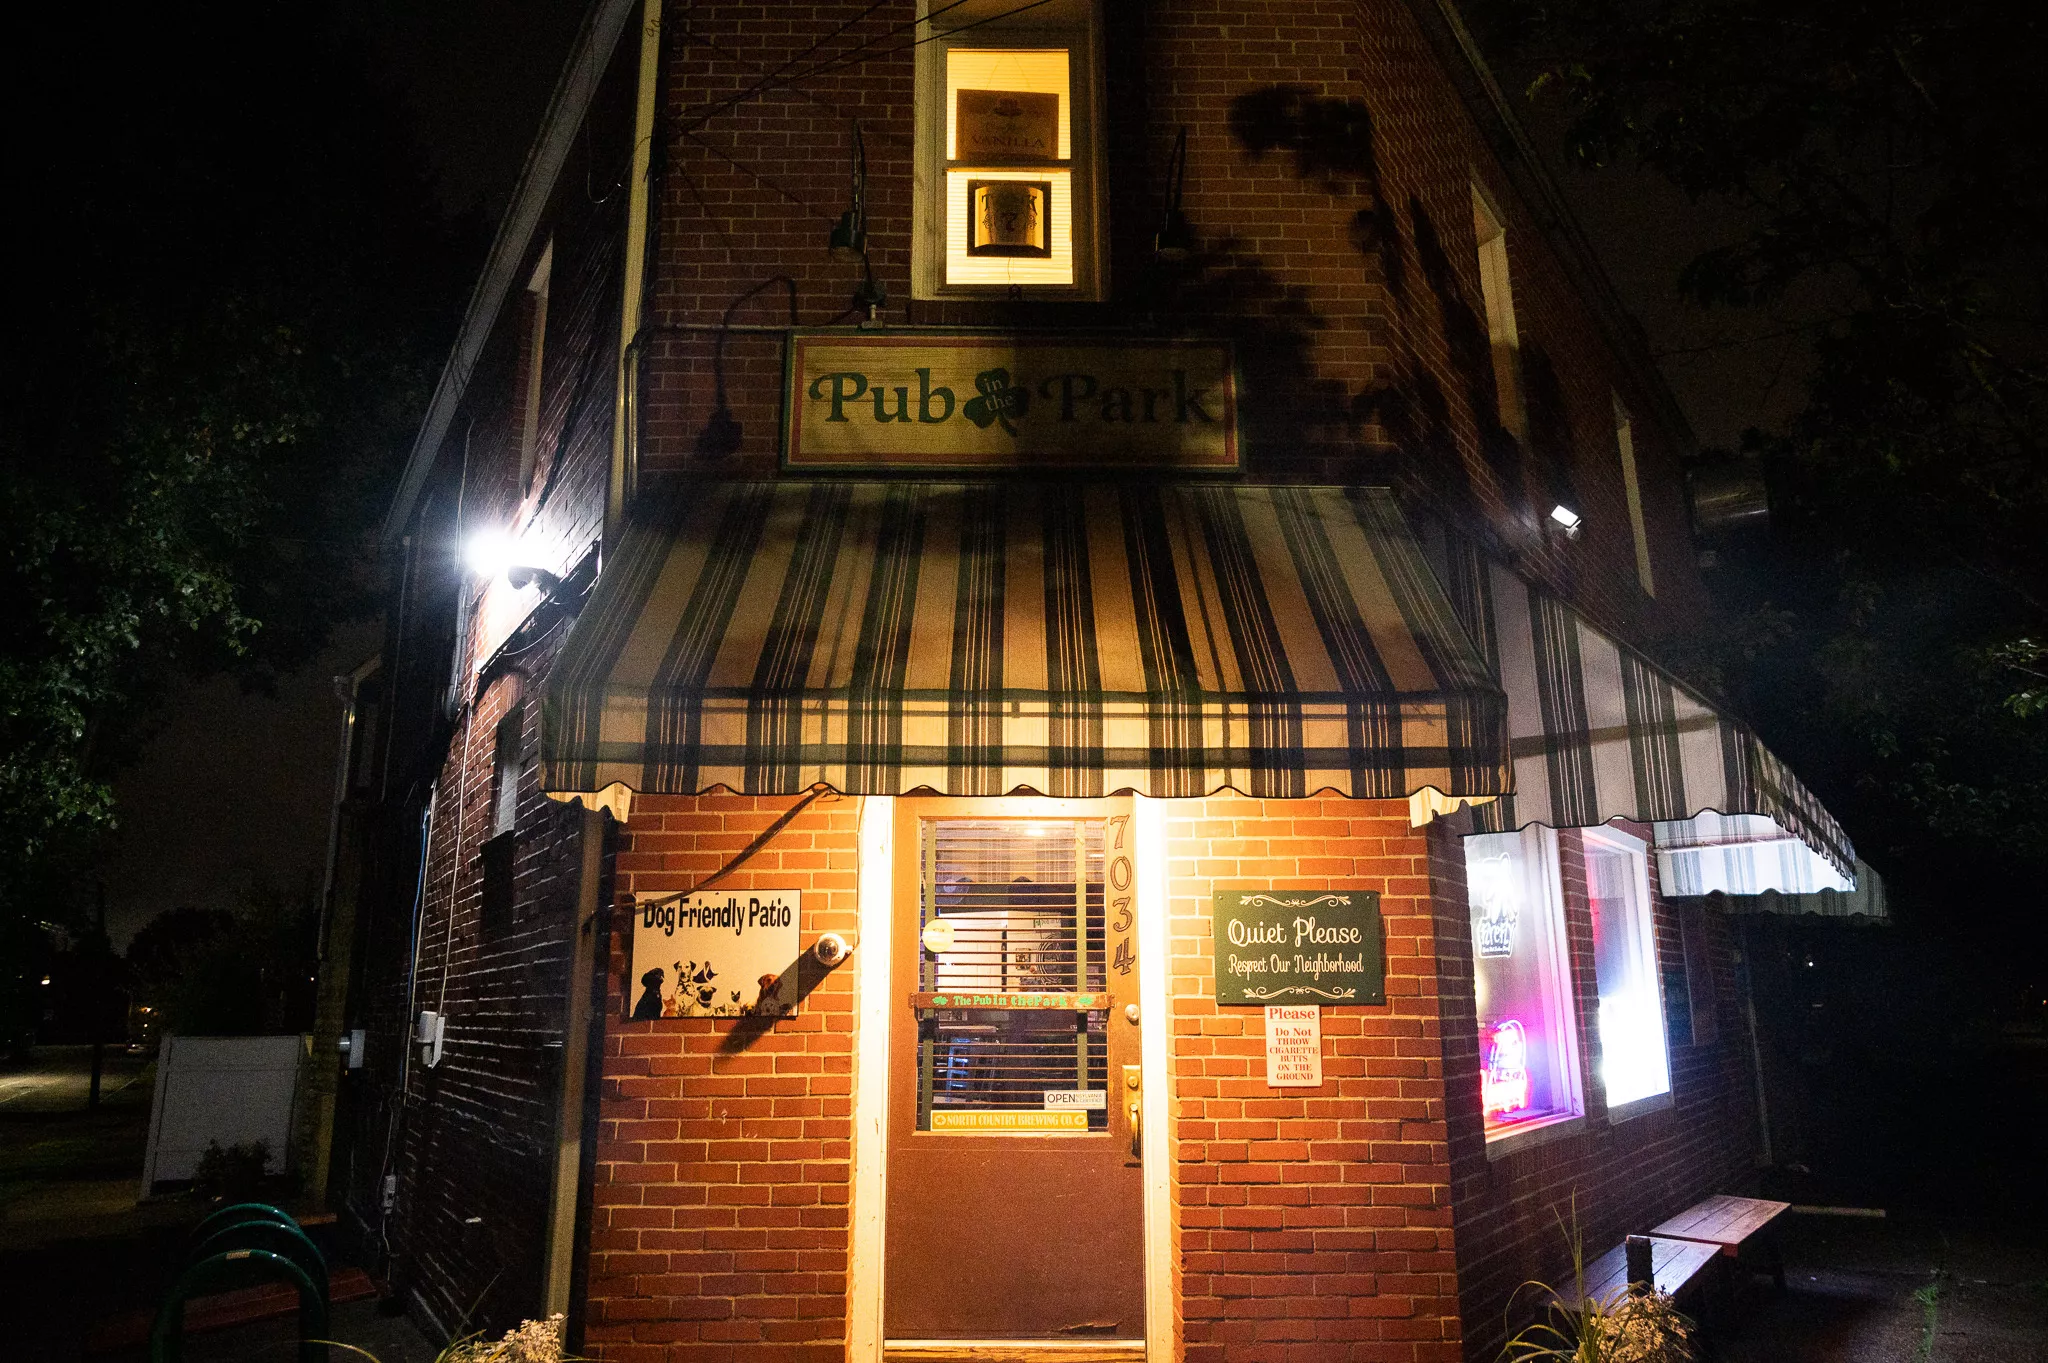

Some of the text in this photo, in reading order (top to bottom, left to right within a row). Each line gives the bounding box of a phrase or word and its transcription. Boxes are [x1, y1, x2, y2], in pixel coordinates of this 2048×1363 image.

[984, 377, 1003, 393] in
[809, 368, 1215, 424] Pub Park
[986, 394, 1015, 412] the
[1109, 814, 1136, 976] 7034
[643, 897, 792, 937] Dog Friendly Patio
[1227, 916, 1363, 948] Quiet Please
[1228, 952, 1364, 981] Respect Our Neighborhood
[953, 994, 1068, 1007] The Pub in the Park
[1269, 1007, 1316, 1020] Please
[1275, 1027, 1312, 1037] Do Not
[1276, 1038, 1310, 1046] THROW
[1269, 1046, 1319, 1054] CIGARETTE
[1280, 1055, 1308, 1063] BUTTS
[1278, 1063, 1312, 1072] ON THE
[1276, 1072, 1314, 1081] GROUND
[1047, 1093, 1076, 1104] OPEN
[947, 1114, 1074, 1127] NORTH COUNTRY BREWING CO.
